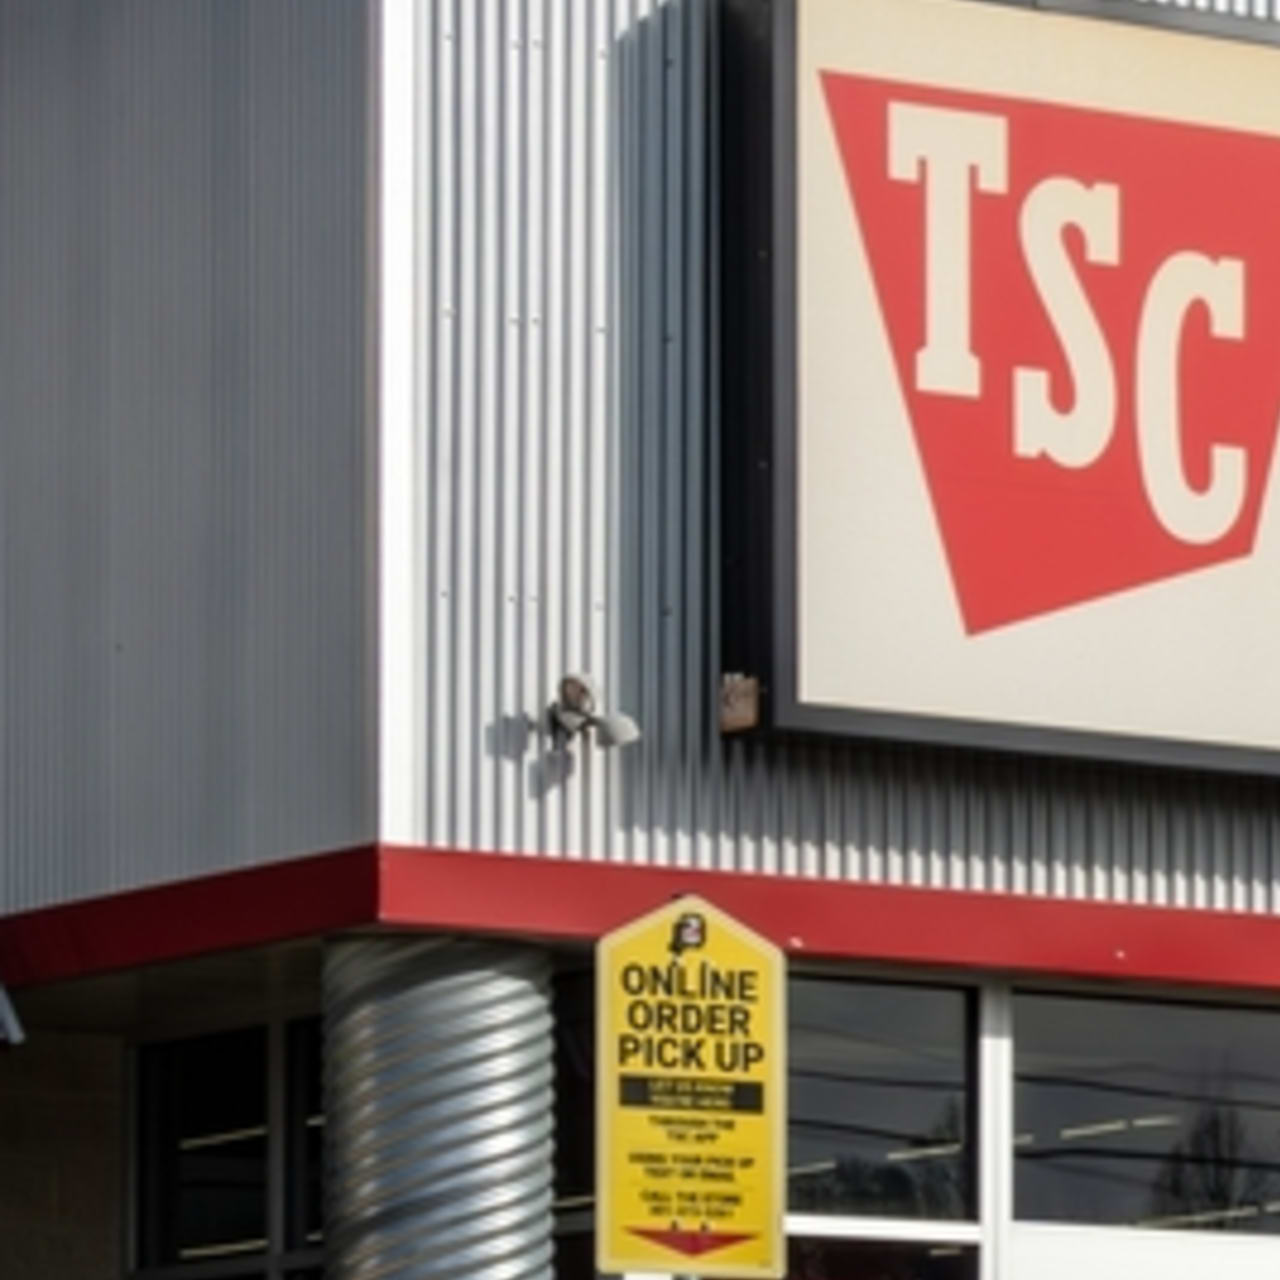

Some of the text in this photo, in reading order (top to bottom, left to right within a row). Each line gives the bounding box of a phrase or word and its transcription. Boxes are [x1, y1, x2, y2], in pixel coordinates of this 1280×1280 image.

[887, 100, 1249, 545] TSC
[620, 961, 759, 1003] ONLINE
[626, 1000, 752, 1037] ORDER
[617, 1034, 765, 1073] PICK UP
